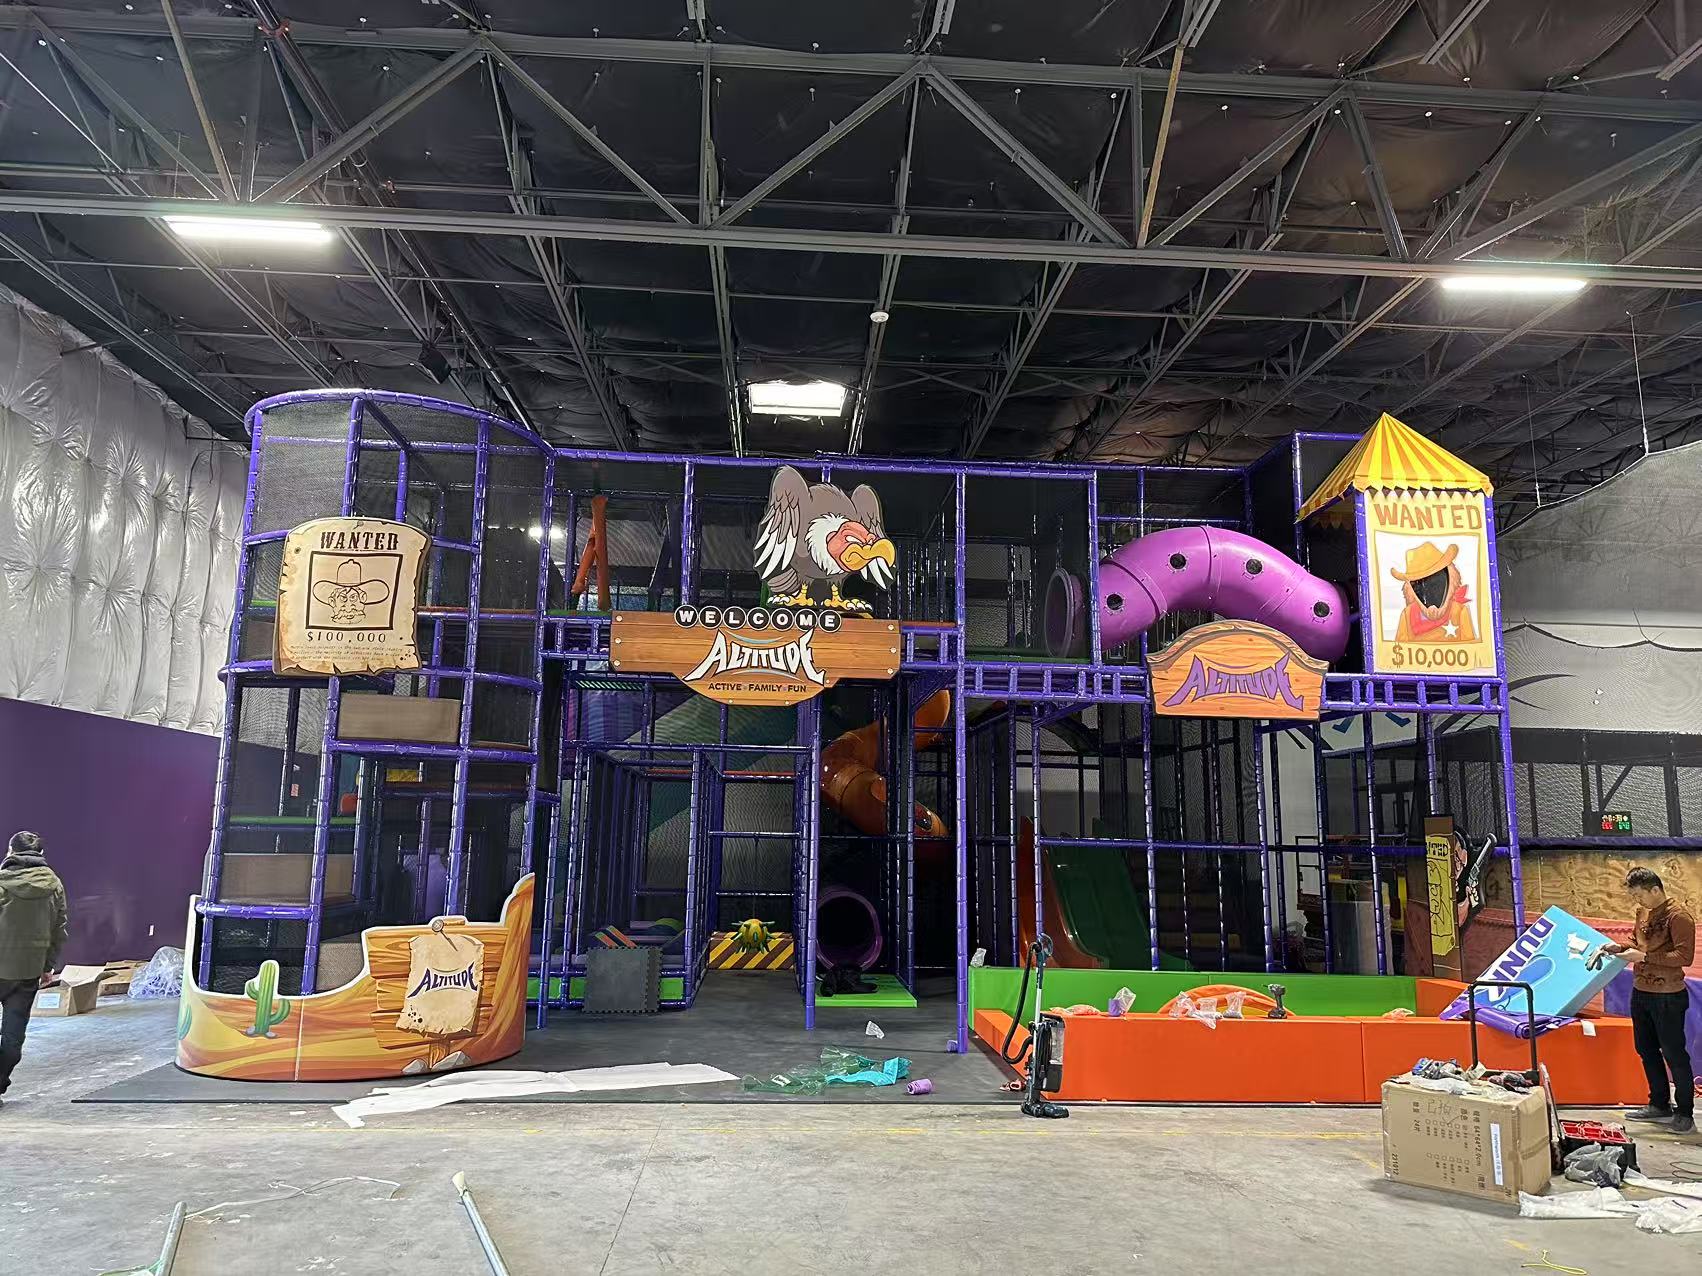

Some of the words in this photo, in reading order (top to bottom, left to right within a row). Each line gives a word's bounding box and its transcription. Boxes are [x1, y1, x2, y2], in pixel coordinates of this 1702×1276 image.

[1374, 503, 1482, 530] WANTED
[320, 531, 399, 551] WANTED
[678, 609, 835, 629] WELCOME
[682, 629, 826, 687] ALTITUDE
[1391, 642, 1469, 668] $10,000
[708, 682, 742, 692] ACTIVE
[748, 684, 782, 693] FAMILY
[787, 684, 807, 693] FUN
[1162, 650, 1304, 712] ALTITUDE
[406, 961, 479, 999] ALTITUDE
